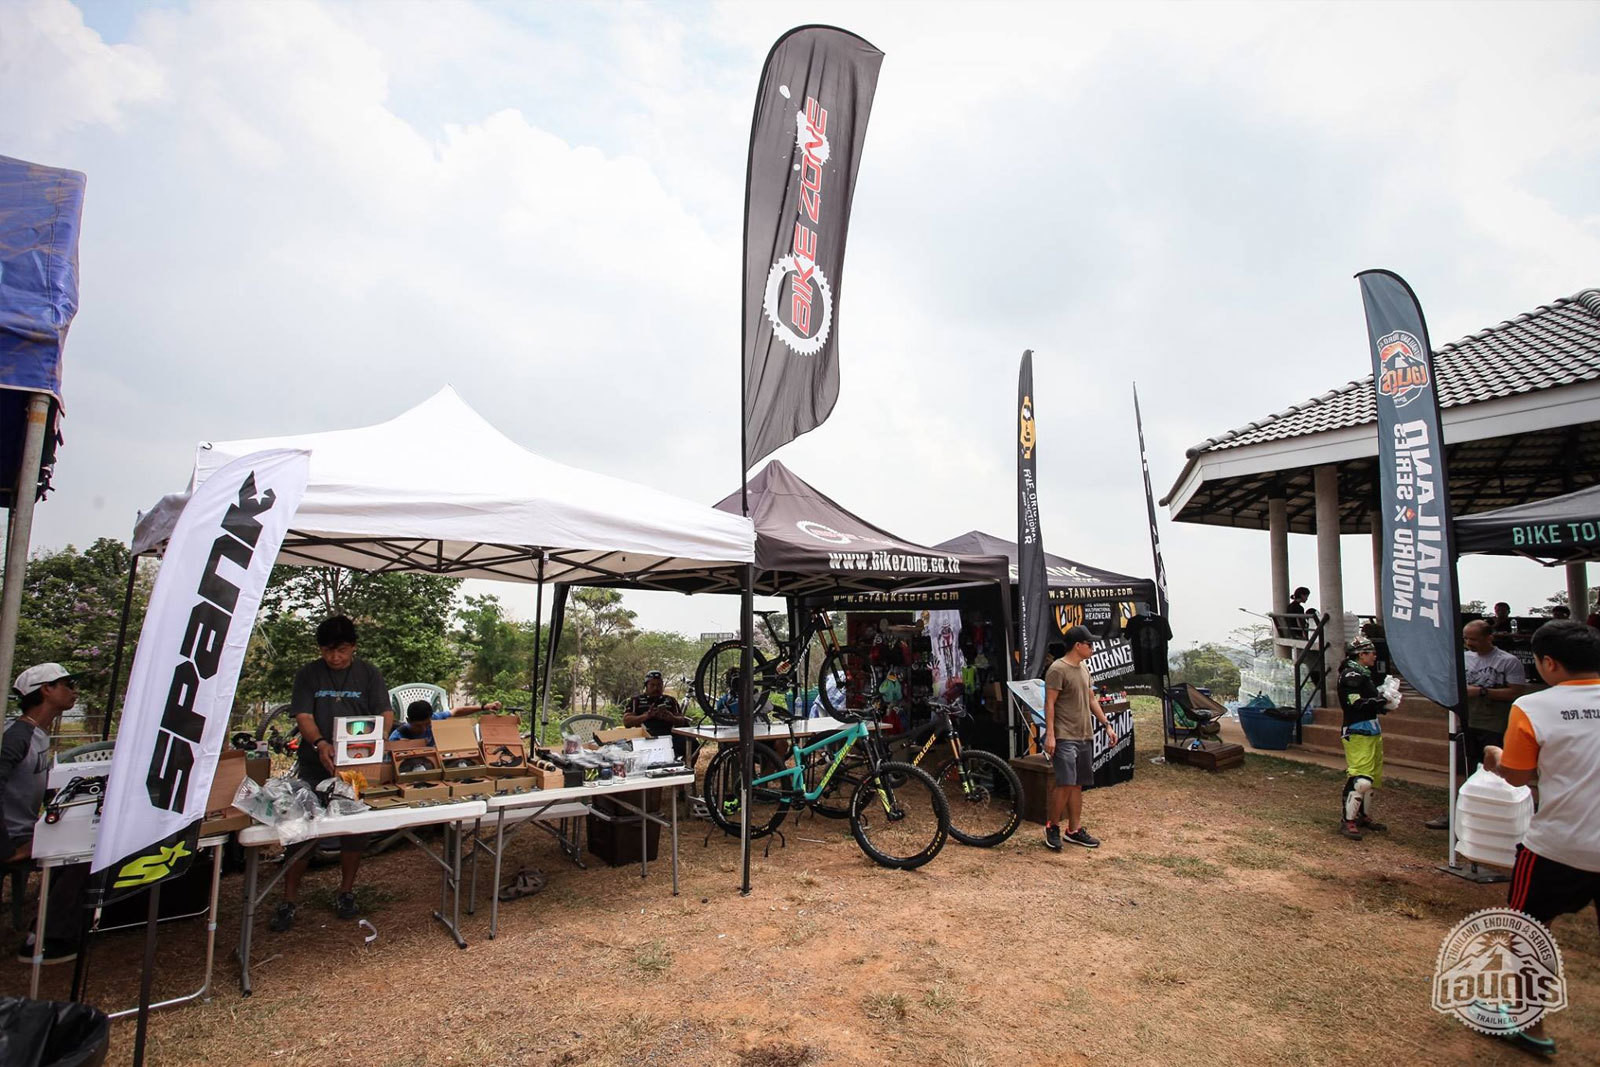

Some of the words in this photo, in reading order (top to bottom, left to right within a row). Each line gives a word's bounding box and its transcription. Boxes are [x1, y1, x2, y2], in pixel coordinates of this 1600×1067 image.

[797, 97, 828, 224] ZONE
[791, 222, 817, 336] BIKE
[1512, 524, 1562, 546] BIKE
[1567, 522, 1600, 542] TO
[828, 551, 961, 574] www.bikezone.co.th
[1048, 586, 1134, 599] w.e-TANKstore.com
